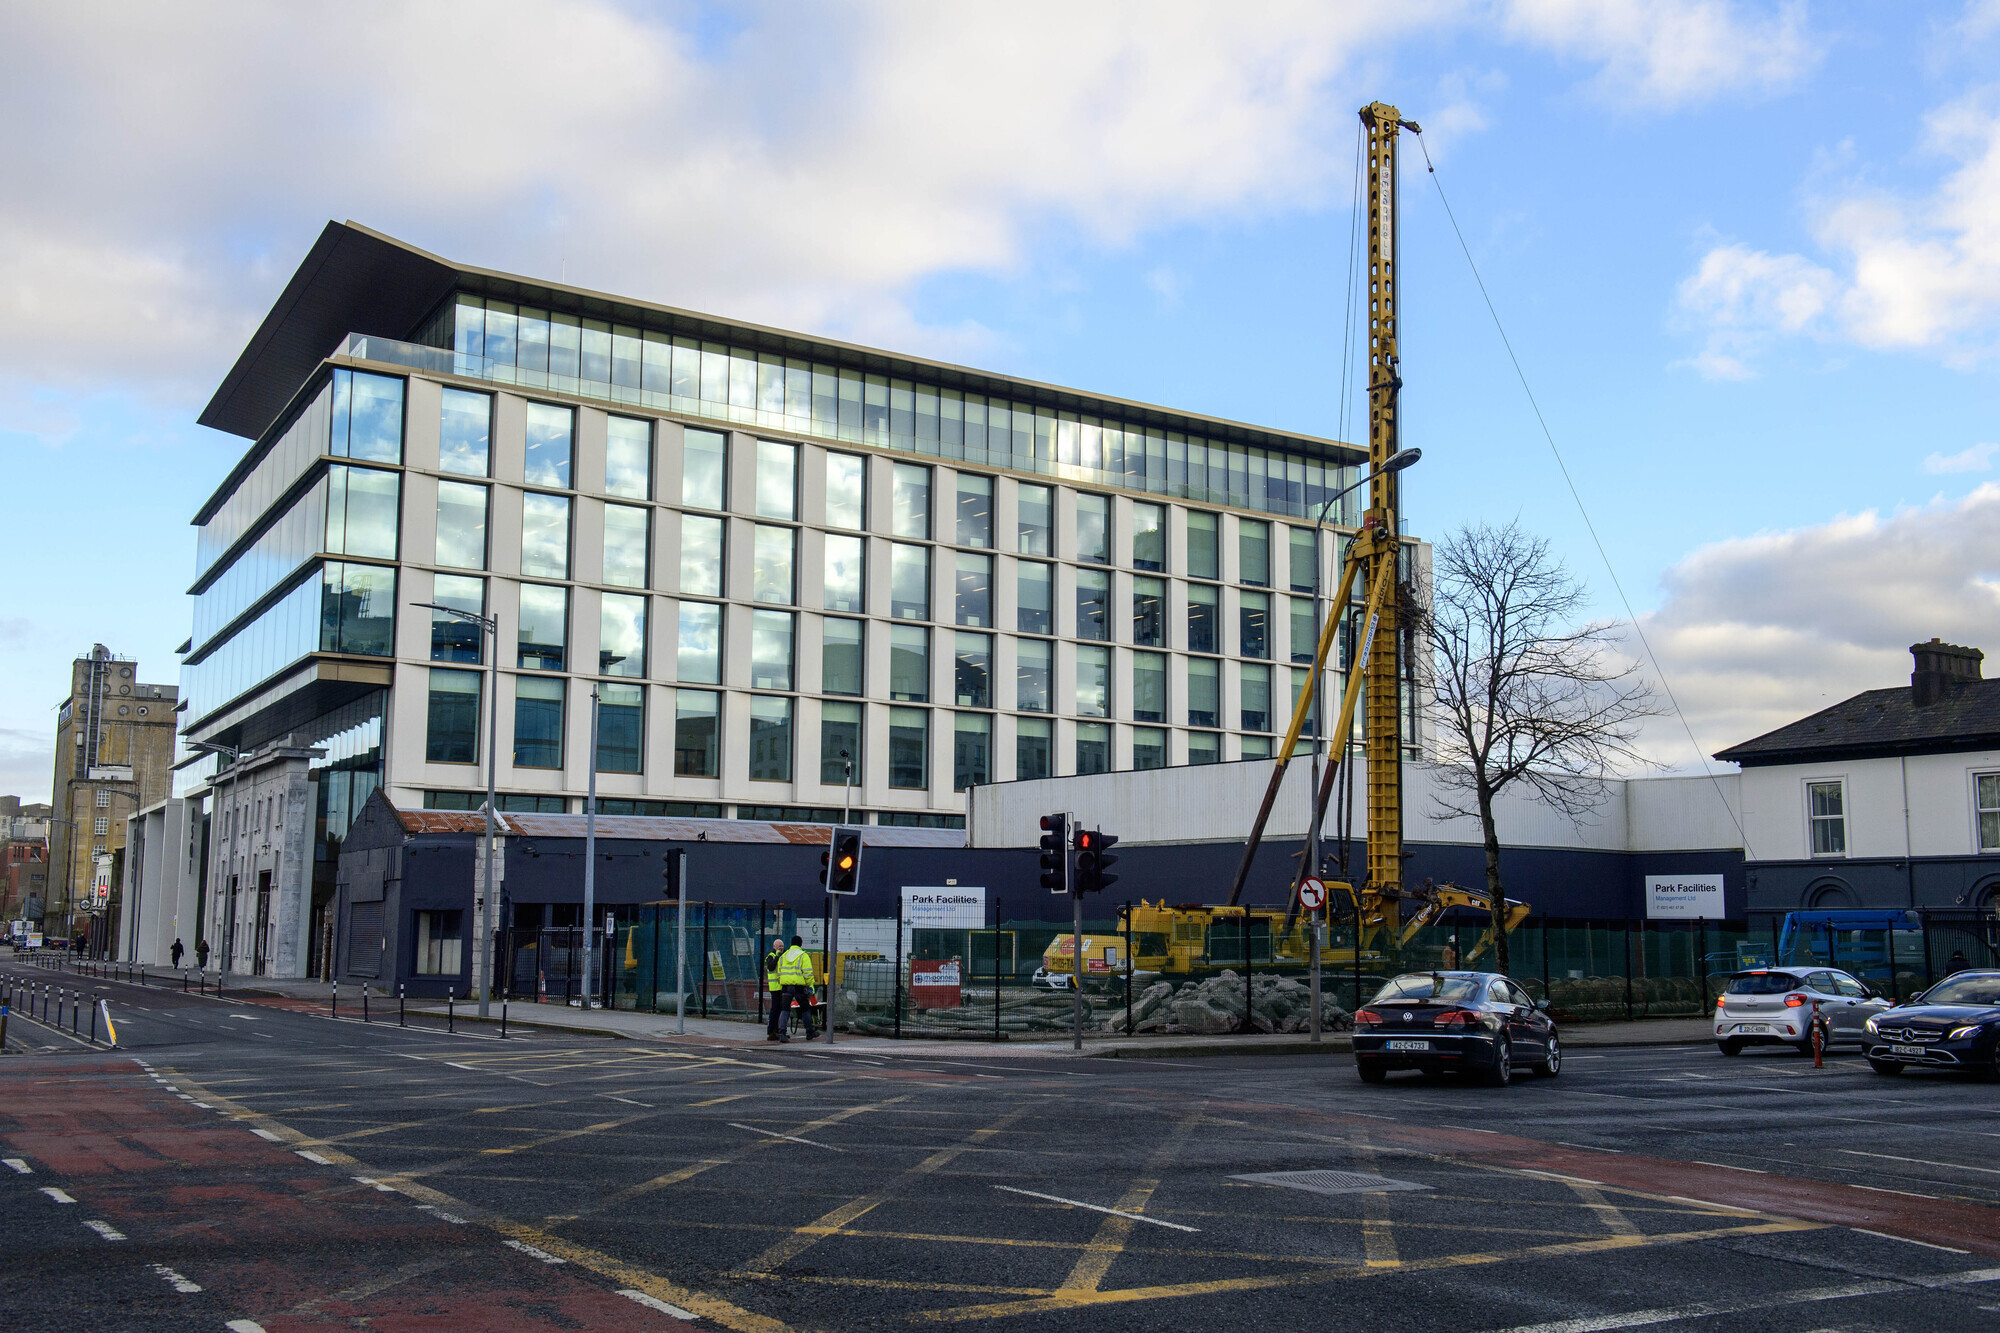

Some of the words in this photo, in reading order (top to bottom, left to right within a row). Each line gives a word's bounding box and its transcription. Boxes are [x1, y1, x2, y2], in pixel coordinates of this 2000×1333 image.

[1655, 884, 1675, 892] Park
[1677, 883, 1717, 892] Facilities
[912, 895, 934, 904] Park
[936, 895, 978, 904] Facilities
